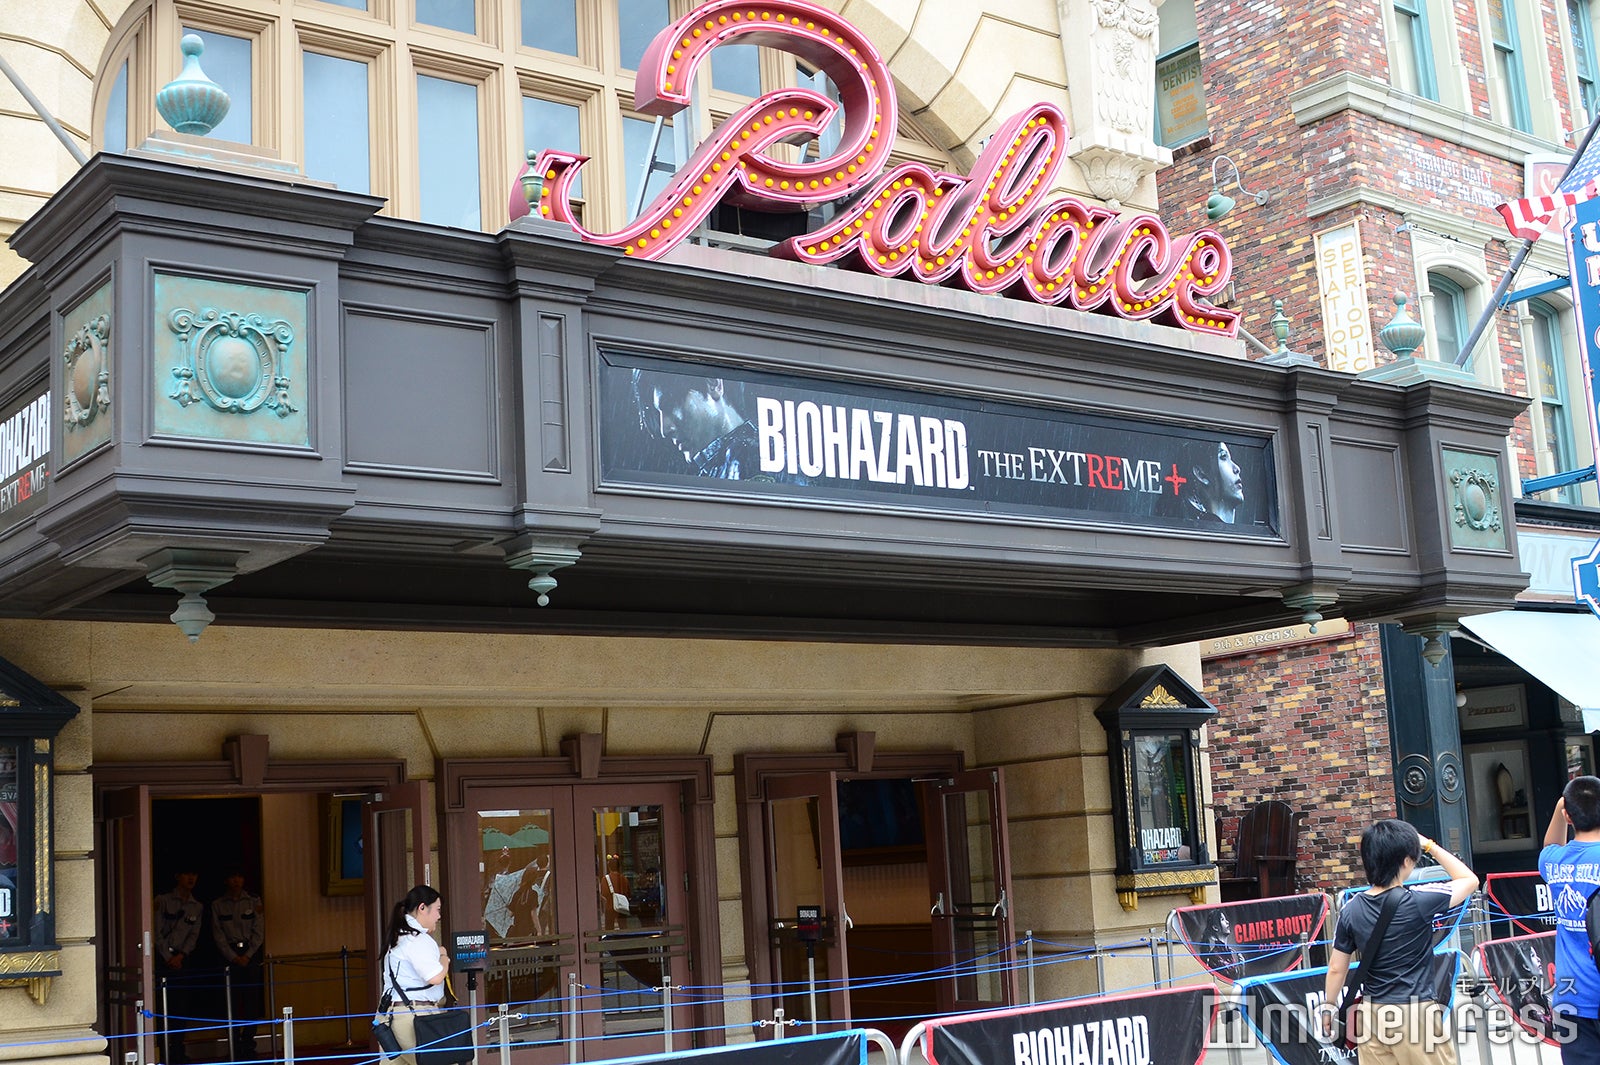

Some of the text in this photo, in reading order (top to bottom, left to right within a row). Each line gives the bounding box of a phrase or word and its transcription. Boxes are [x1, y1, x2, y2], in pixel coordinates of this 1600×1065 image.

[509, 0, 1242, 338] Palace
[1461, 164, 1492, 188] DAILY
[1341, 242, 1367, 371] PERIODIC
[978, 450, 1025, 480] THE
[1235, 638, 1243, 648] &
[1248, 631, 1281, 645] ARCH
[1234, 919, 1274, 943] CLAIRE
